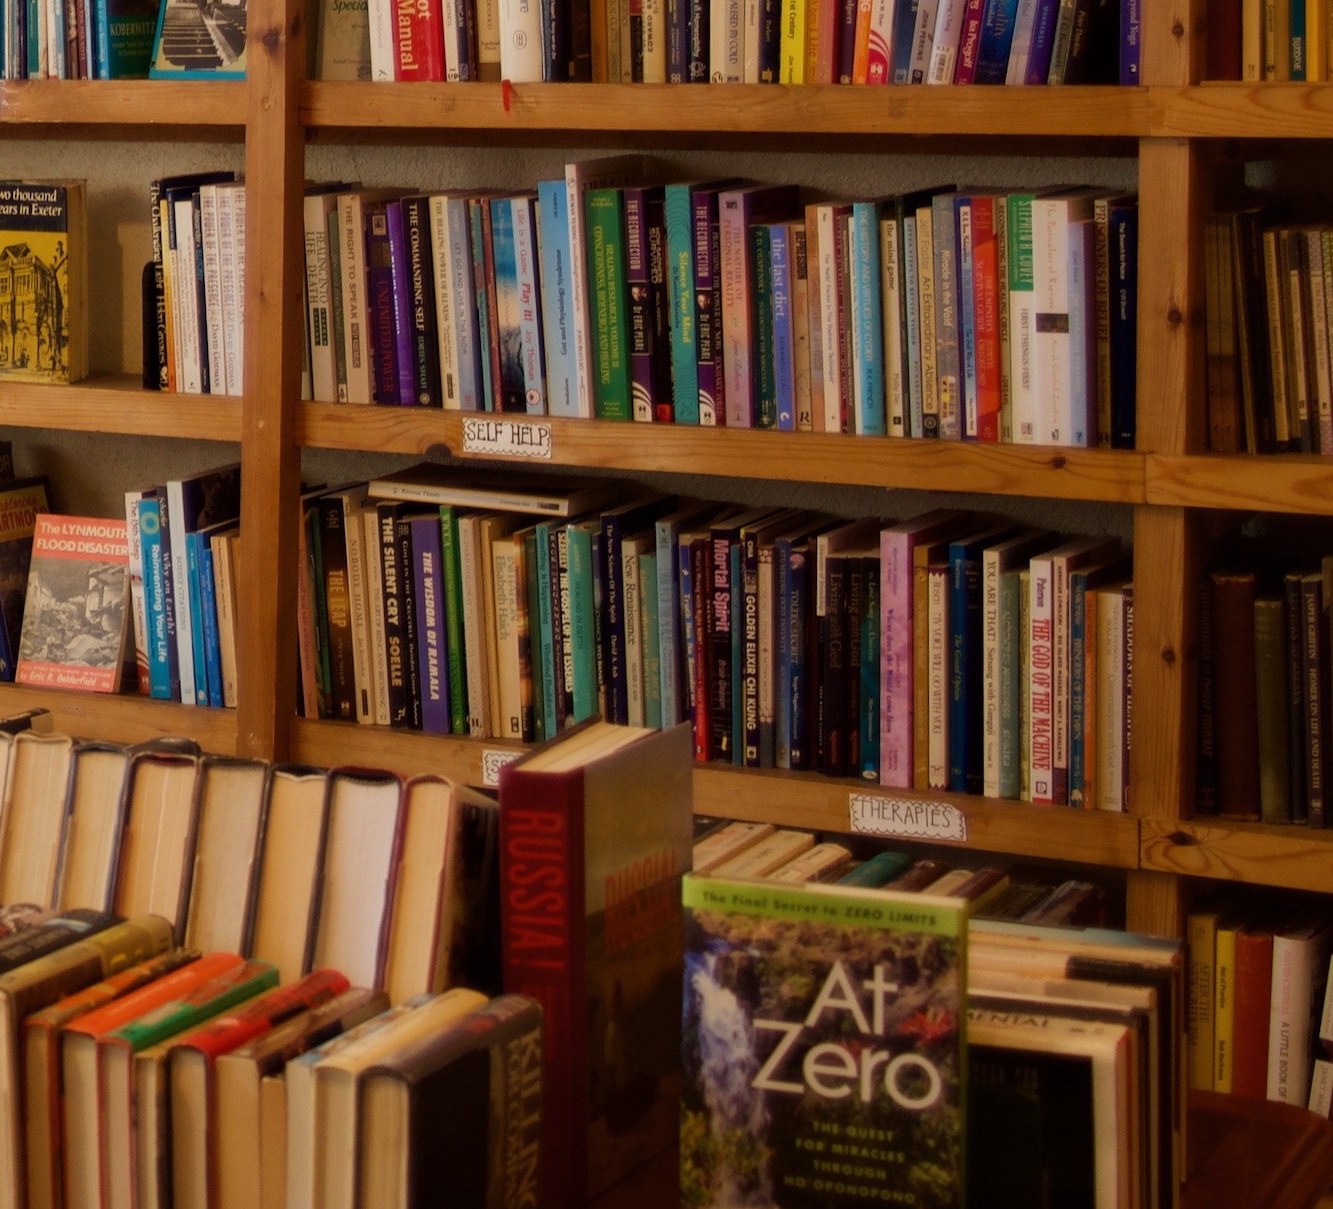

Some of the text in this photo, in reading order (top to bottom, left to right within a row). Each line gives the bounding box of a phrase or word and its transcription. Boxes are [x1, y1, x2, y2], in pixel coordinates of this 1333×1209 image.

[12, 188, 57, 203] thousand
[19, 203, 30, 216] in
[32, 204, 62, 217] Exeter
[467, 421, 548, 446] SELF HELP
[37, 538, 130, 557] FLOOD DISASTER
[40, 521, 130, 541] The LYNMOUTH
[382, 517, 402, 686] THE SILENT CRY SOELLE
[713, 539, 730, 632] Mortal Spirit
[745, 595, 756, 730] GOLDEN ELIXIR CHI KUNG
[1032, 619, 1051, 770] THE GOD OF THE MACHINE
[860, 798, 952, 828] THERAPIES
[507, 809, 565, 969] RUSSIA!
[703, 892, 937, 926] The Final Secret to ZERO LIMITS
[803, 960, 899, 1036] At
[751, 1018, 942, 1110] Zero
